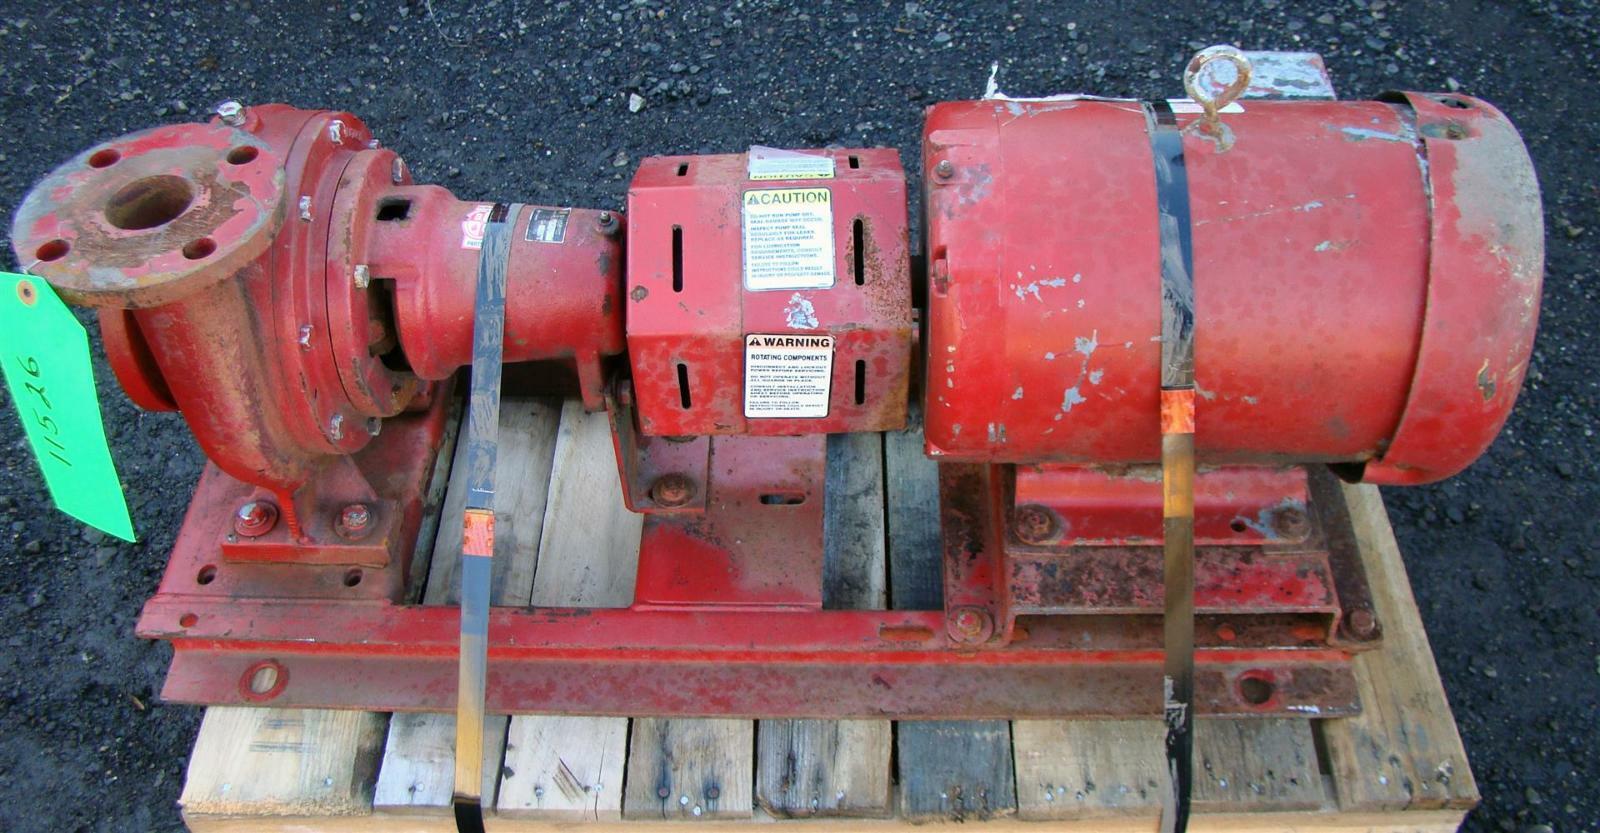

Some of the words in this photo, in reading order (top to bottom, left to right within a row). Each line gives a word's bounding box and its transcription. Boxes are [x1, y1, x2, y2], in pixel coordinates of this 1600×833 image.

[761, 192, 827, 204] CAUTION
[764, 338, 829, 347] WARNING
[783, 354, 828, 362] COMPONENTS
[15, 355, 73, 468] 11526
